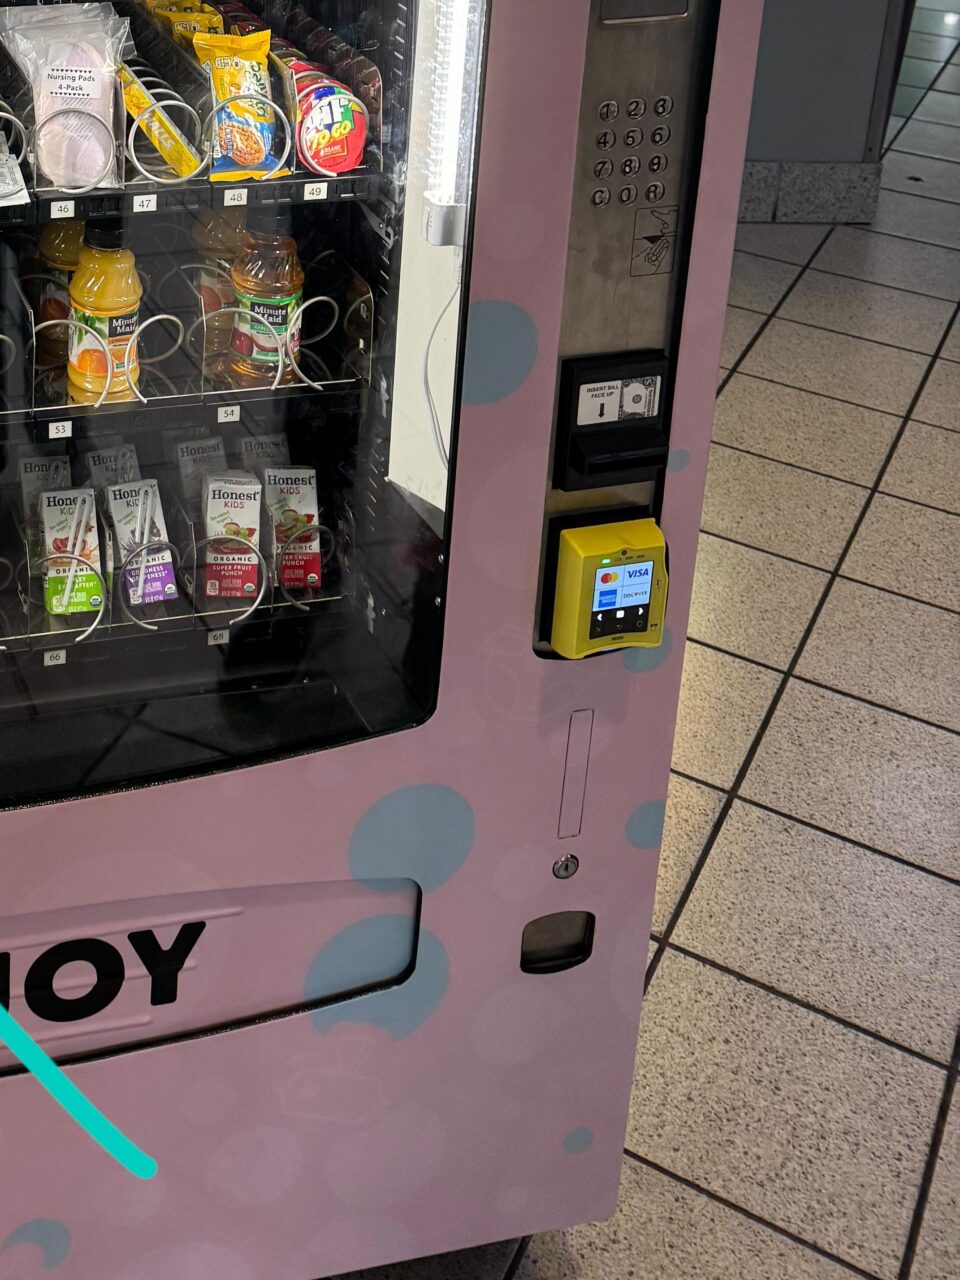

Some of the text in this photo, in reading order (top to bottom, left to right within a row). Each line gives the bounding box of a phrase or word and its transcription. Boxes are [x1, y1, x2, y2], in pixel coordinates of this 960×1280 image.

[47, 73, 96, 83] Nursing Pads
[58, 83, 84, 92] 4-Pack
[601, 98, 666, 119] 1 2 3
[331, 120, 352, 140] GO
[597, 127, 664, 148] 4 5 6
[595, 155, 661, 177] 7 8 9
[309, 187, 322, 197] 49
[592, 189, 605, 205] C
[646, 183, 659, 199] R
[230, 193, 243, 202] 48
[57, 205, 69, 213] 46
[138, 200, 152, 208] 47
[254, 305, 287, 315] Minute
[586, 385, 607, 393] INSERT
[591, 391, 606, 399] FACE
[223, 409, 235, 417] 54
[55, 425, 66, 434] 53
[267, 474, 317, 486] Honest
[212, 489, 260, 501] Honest
[627, 568, 649, 579] VISA
[212, 632, 224, 641] 68
[49, 653, 61, 662] 66
